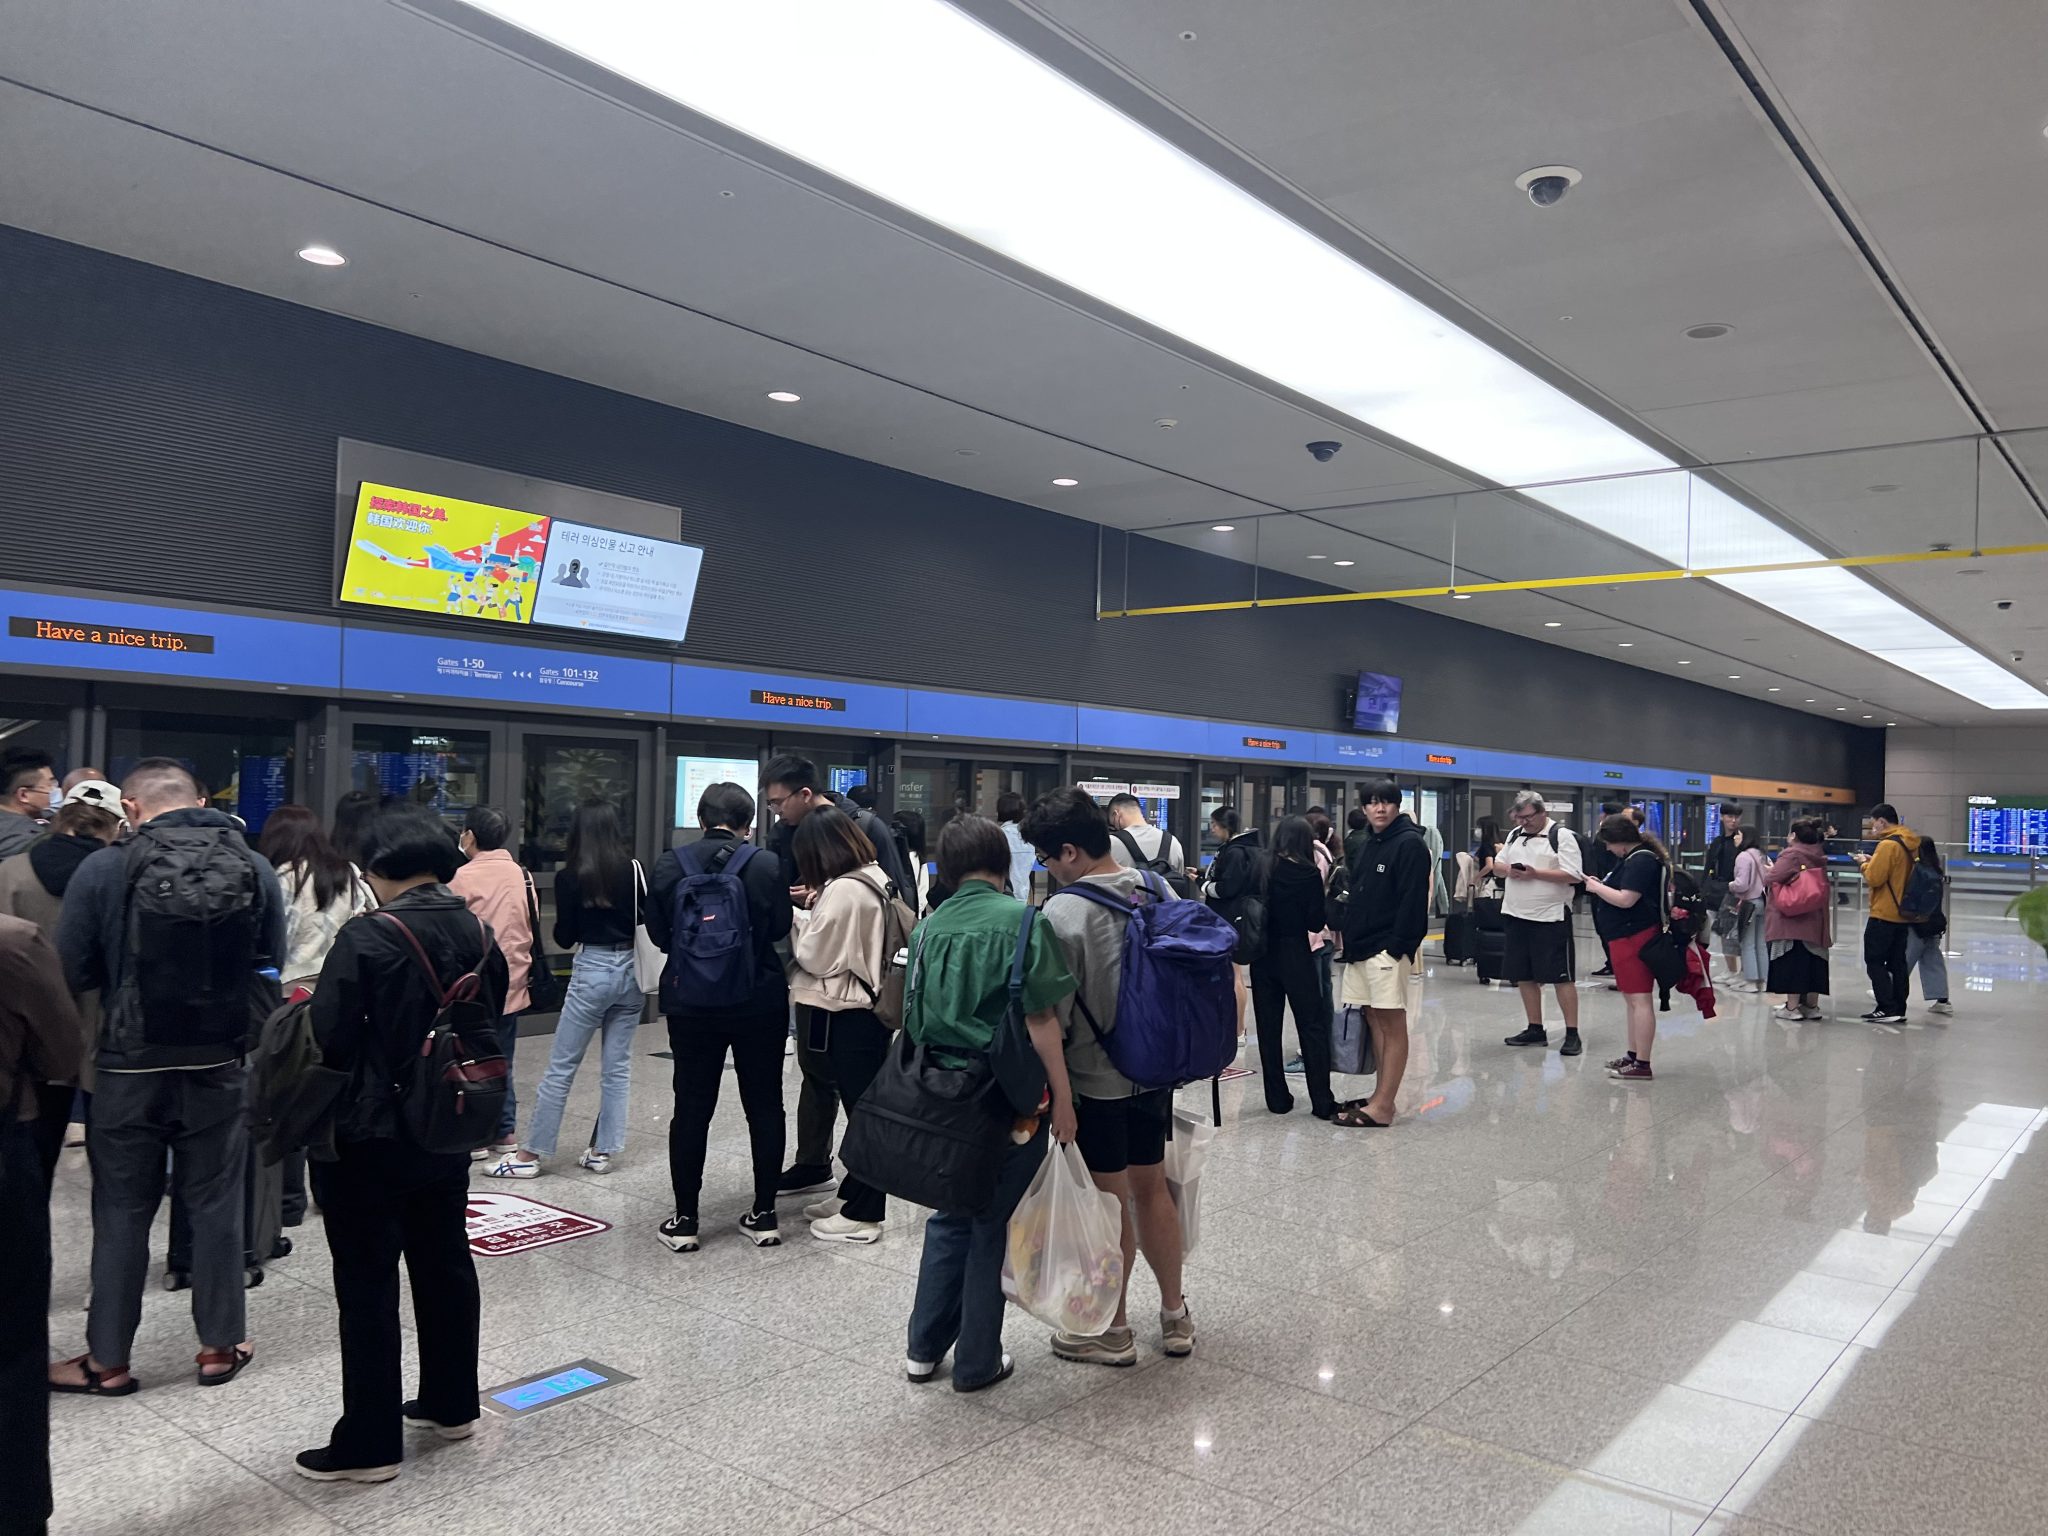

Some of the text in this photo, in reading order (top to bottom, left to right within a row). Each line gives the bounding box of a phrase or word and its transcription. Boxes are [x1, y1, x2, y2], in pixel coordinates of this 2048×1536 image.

[561, 531, 580, 544] 테러
[619, 542, 635, 553] 신고
[638, 544, 655, 557] 안내
[36, 620, 187, 651] Have a nice trip.
[437, 657, 485, 669] Gates 1-50
[539, 667, 599, 680] Gates 101-132
[762, 691, 833, 710] Have a nice trip.
[487, 1223, 590, 1250] Baggage Claim
